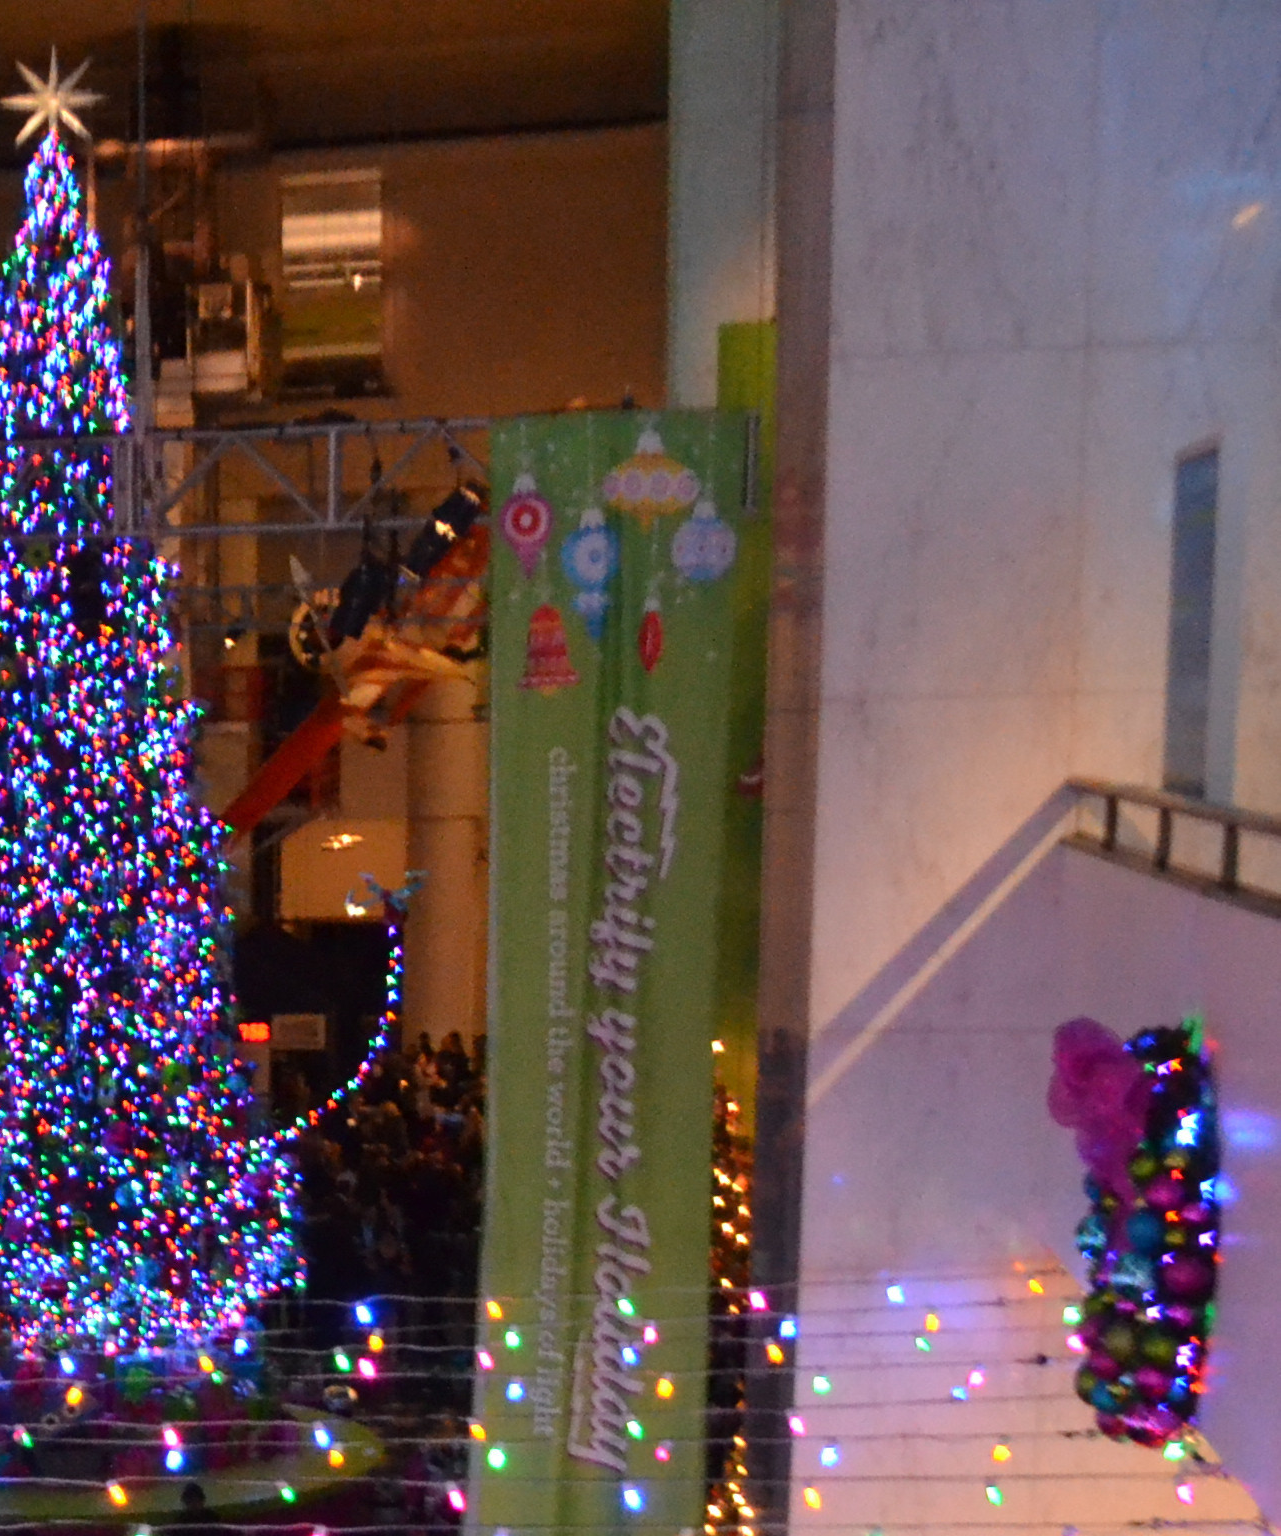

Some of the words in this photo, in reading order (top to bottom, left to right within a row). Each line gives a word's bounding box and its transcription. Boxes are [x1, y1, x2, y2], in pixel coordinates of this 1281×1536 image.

[589, 705, 678, 996] Electrify
[545, 1082, 574, 1169] world
[587, 1007, 640, 1180] your
[534, 1200, 570, 1321] holidays
[568, 1192, 650, 1475] Holiday
